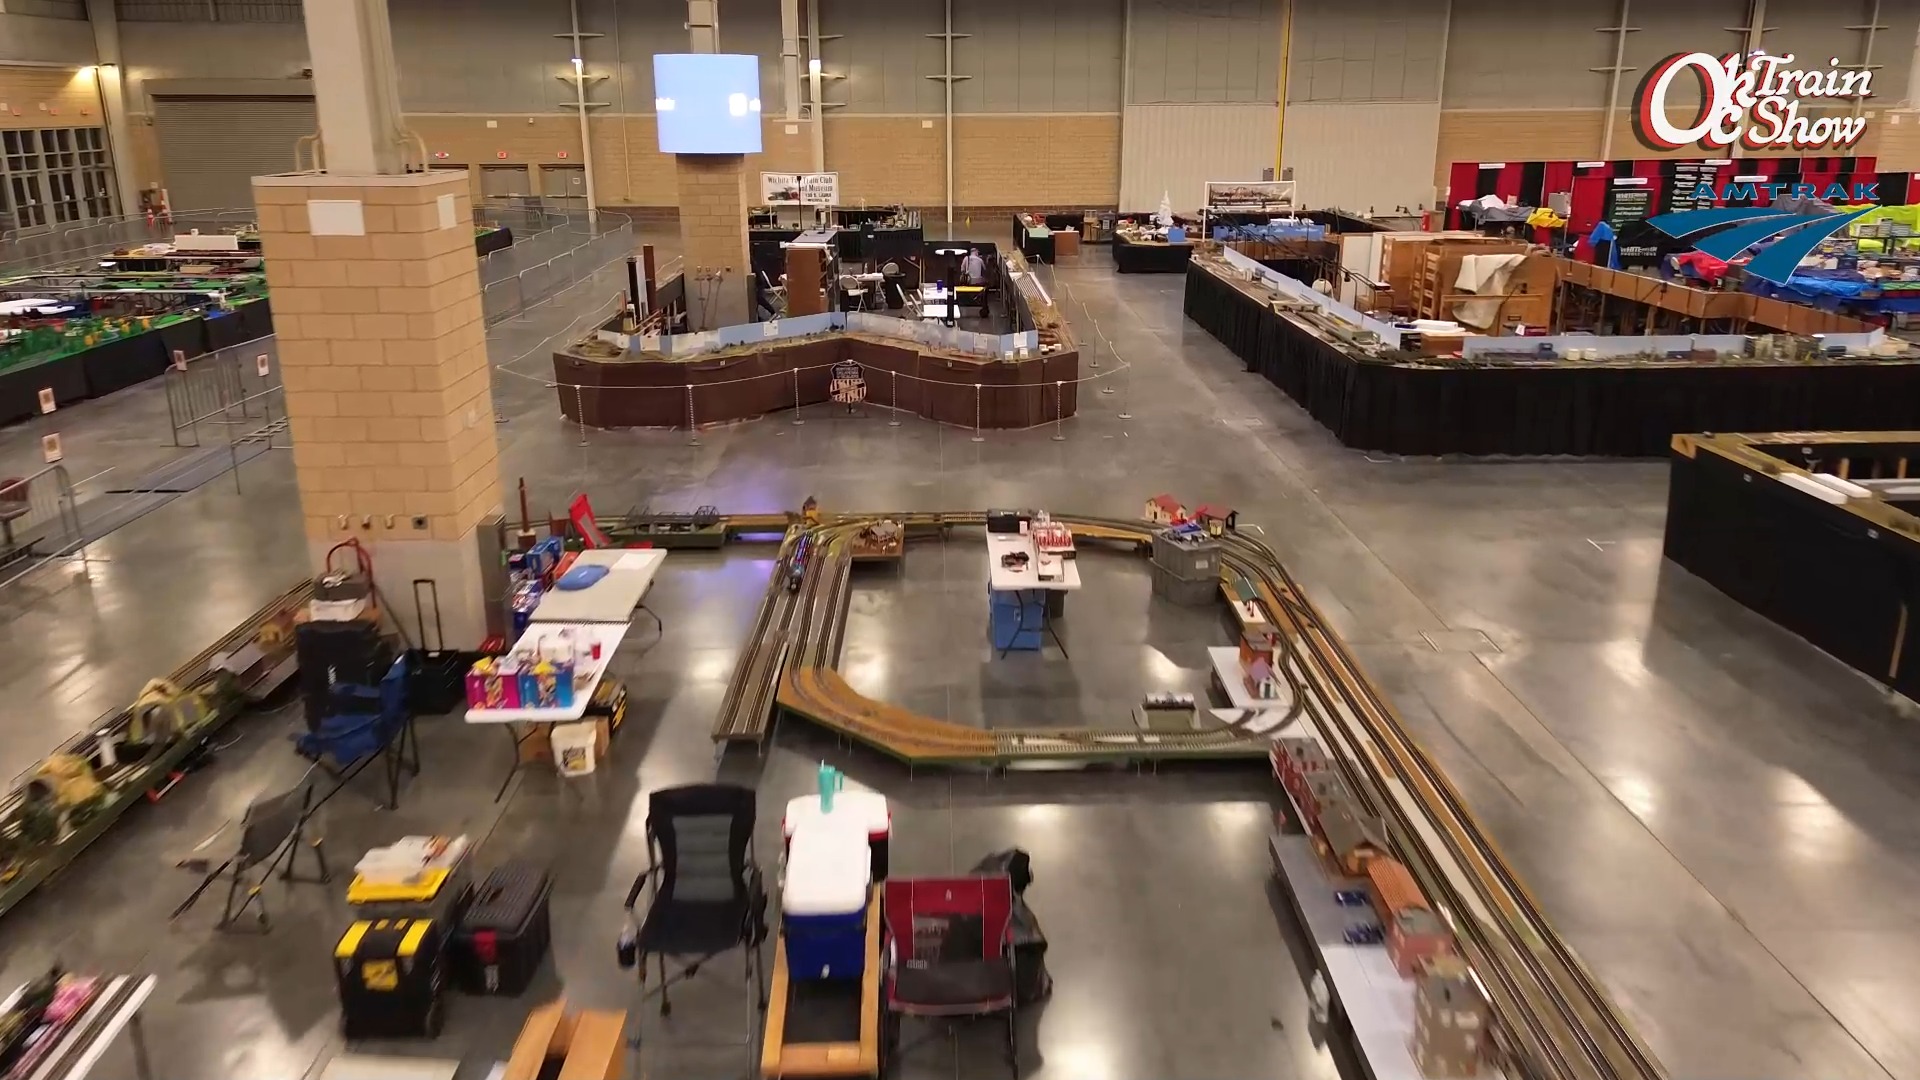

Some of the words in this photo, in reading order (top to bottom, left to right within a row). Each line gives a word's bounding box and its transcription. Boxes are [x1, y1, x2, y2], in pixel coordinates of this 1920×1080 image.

[803, 176, 818, 184] Train
[820, 176, 833, 184] Club
[809, 184, 833, 192] Museum
